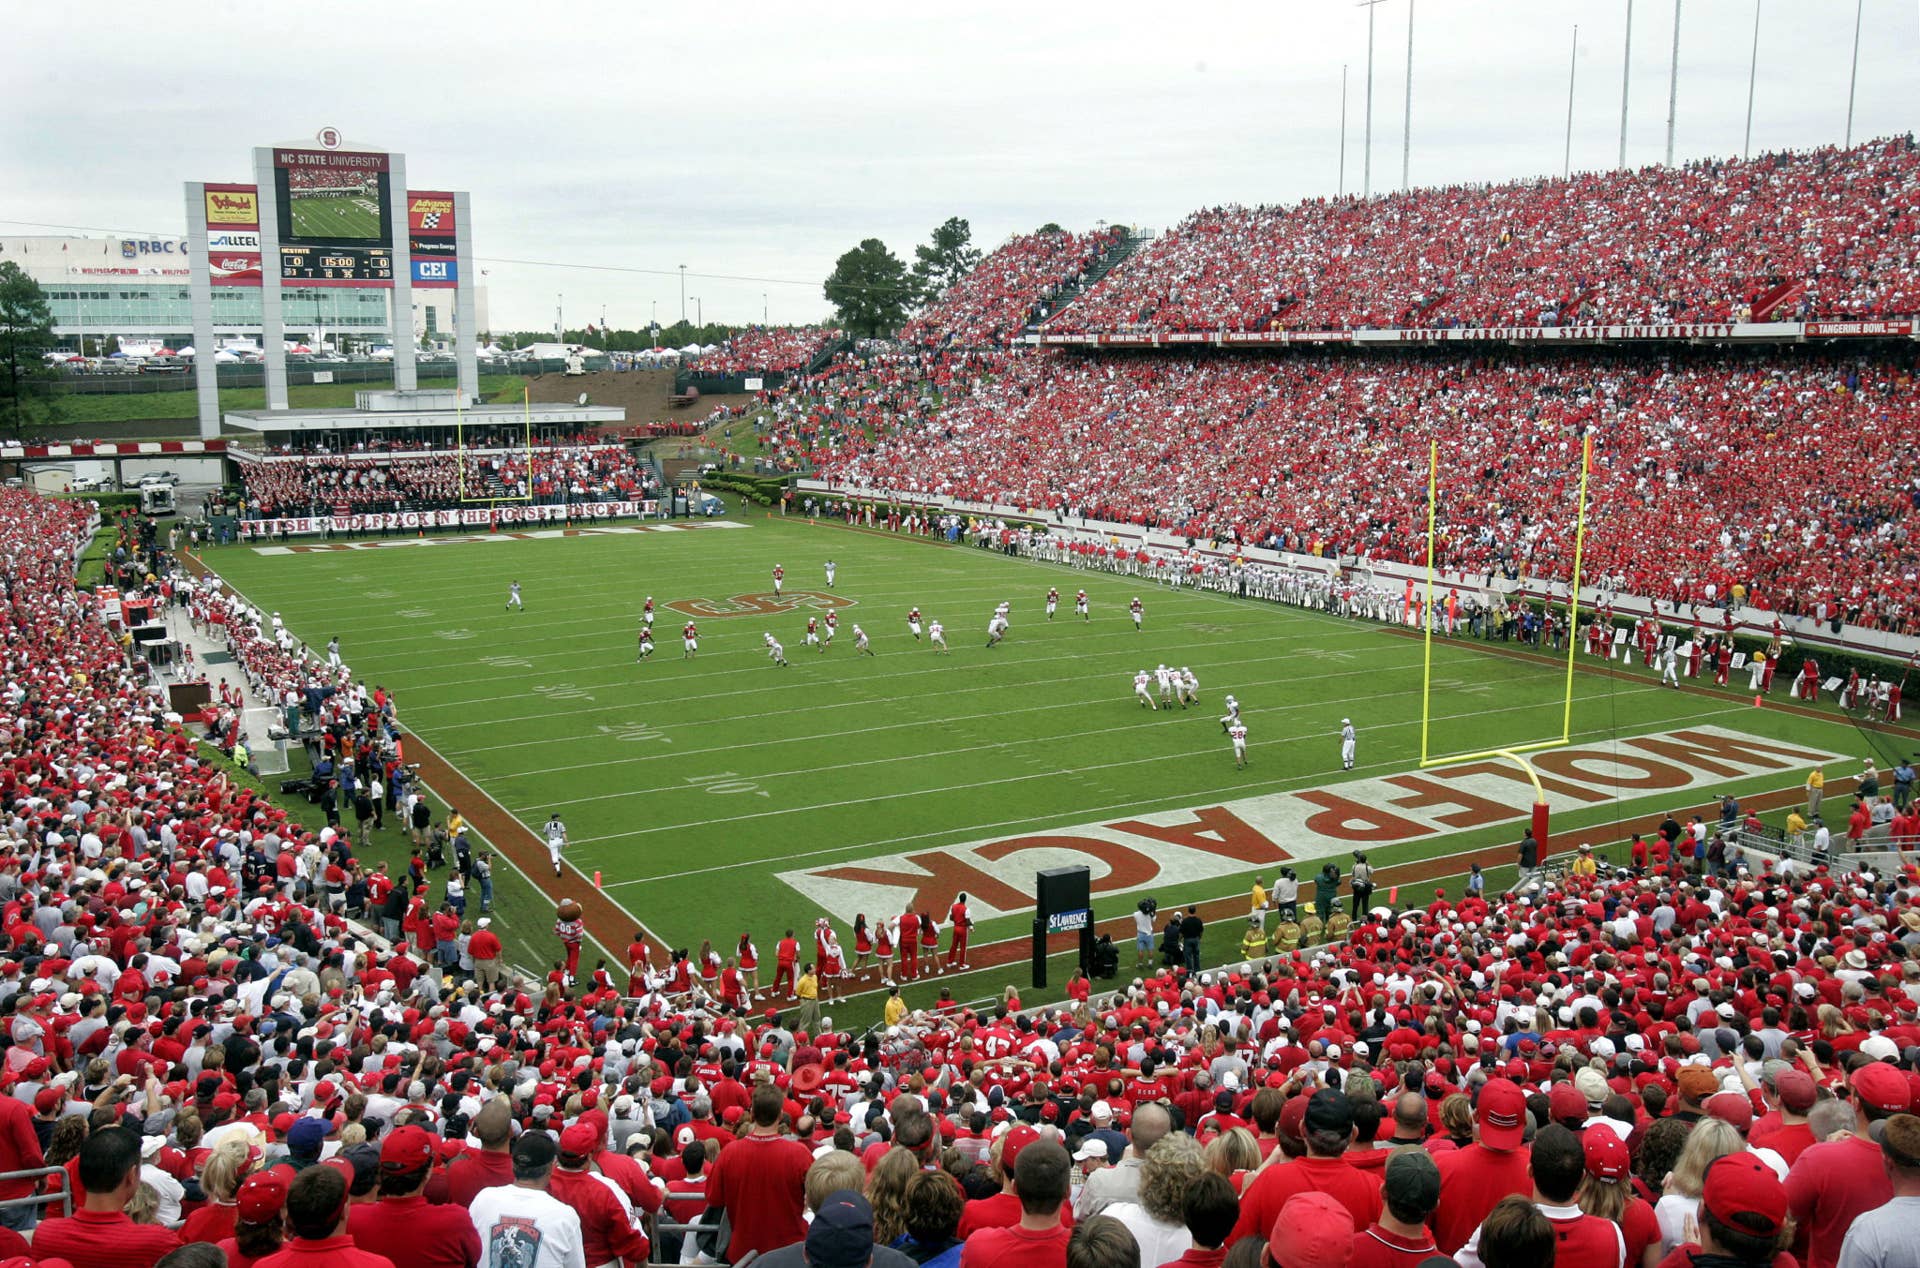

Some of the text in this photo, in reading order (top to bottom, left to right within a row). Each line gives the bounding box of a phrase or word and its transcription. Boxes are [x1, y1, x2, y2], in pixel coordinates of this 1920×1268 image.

[281, 153, 383, 168] NC STATE UNIVERSITY
[416, 199, 452, 208] Advance
[139, 241, 174, 254] RBC
[210, 235, 258, 247] ALLTEL
[440, 243, 456, 251] Energy
[324, 258, 353, 267] 15:00
[419, 262, 447, 278] CEI
[1400, 325, 1736, 341] NORTH CAROLINA STATE UNIVERSITY
[1818, 323, 1862, 335] TANGERINE
[1863, 322, 1887, 334] BOWL
[1230, 333, 1247, 341] PEACH
[1248, 333, 1263, 341] BOWL
[333, 511, 429, 531] WOLFPACK
[455, 508, 488, 523] THE
[493, 506, 547, 521] HOUSE
[1231, 730, 1244, 740] 28
[682, 771, 760, 794] 10
[806, 729, 1838, 913] WOLFPACK
[370, 884, 379, 899] 4
[406, 904, 415, 917] 7
[264, 914, 276, 931] 5
[560, 922, 571, 934] 00
[985, 1036, 1010, 1057] 47
[825, 1083, 852, 1099] 75
